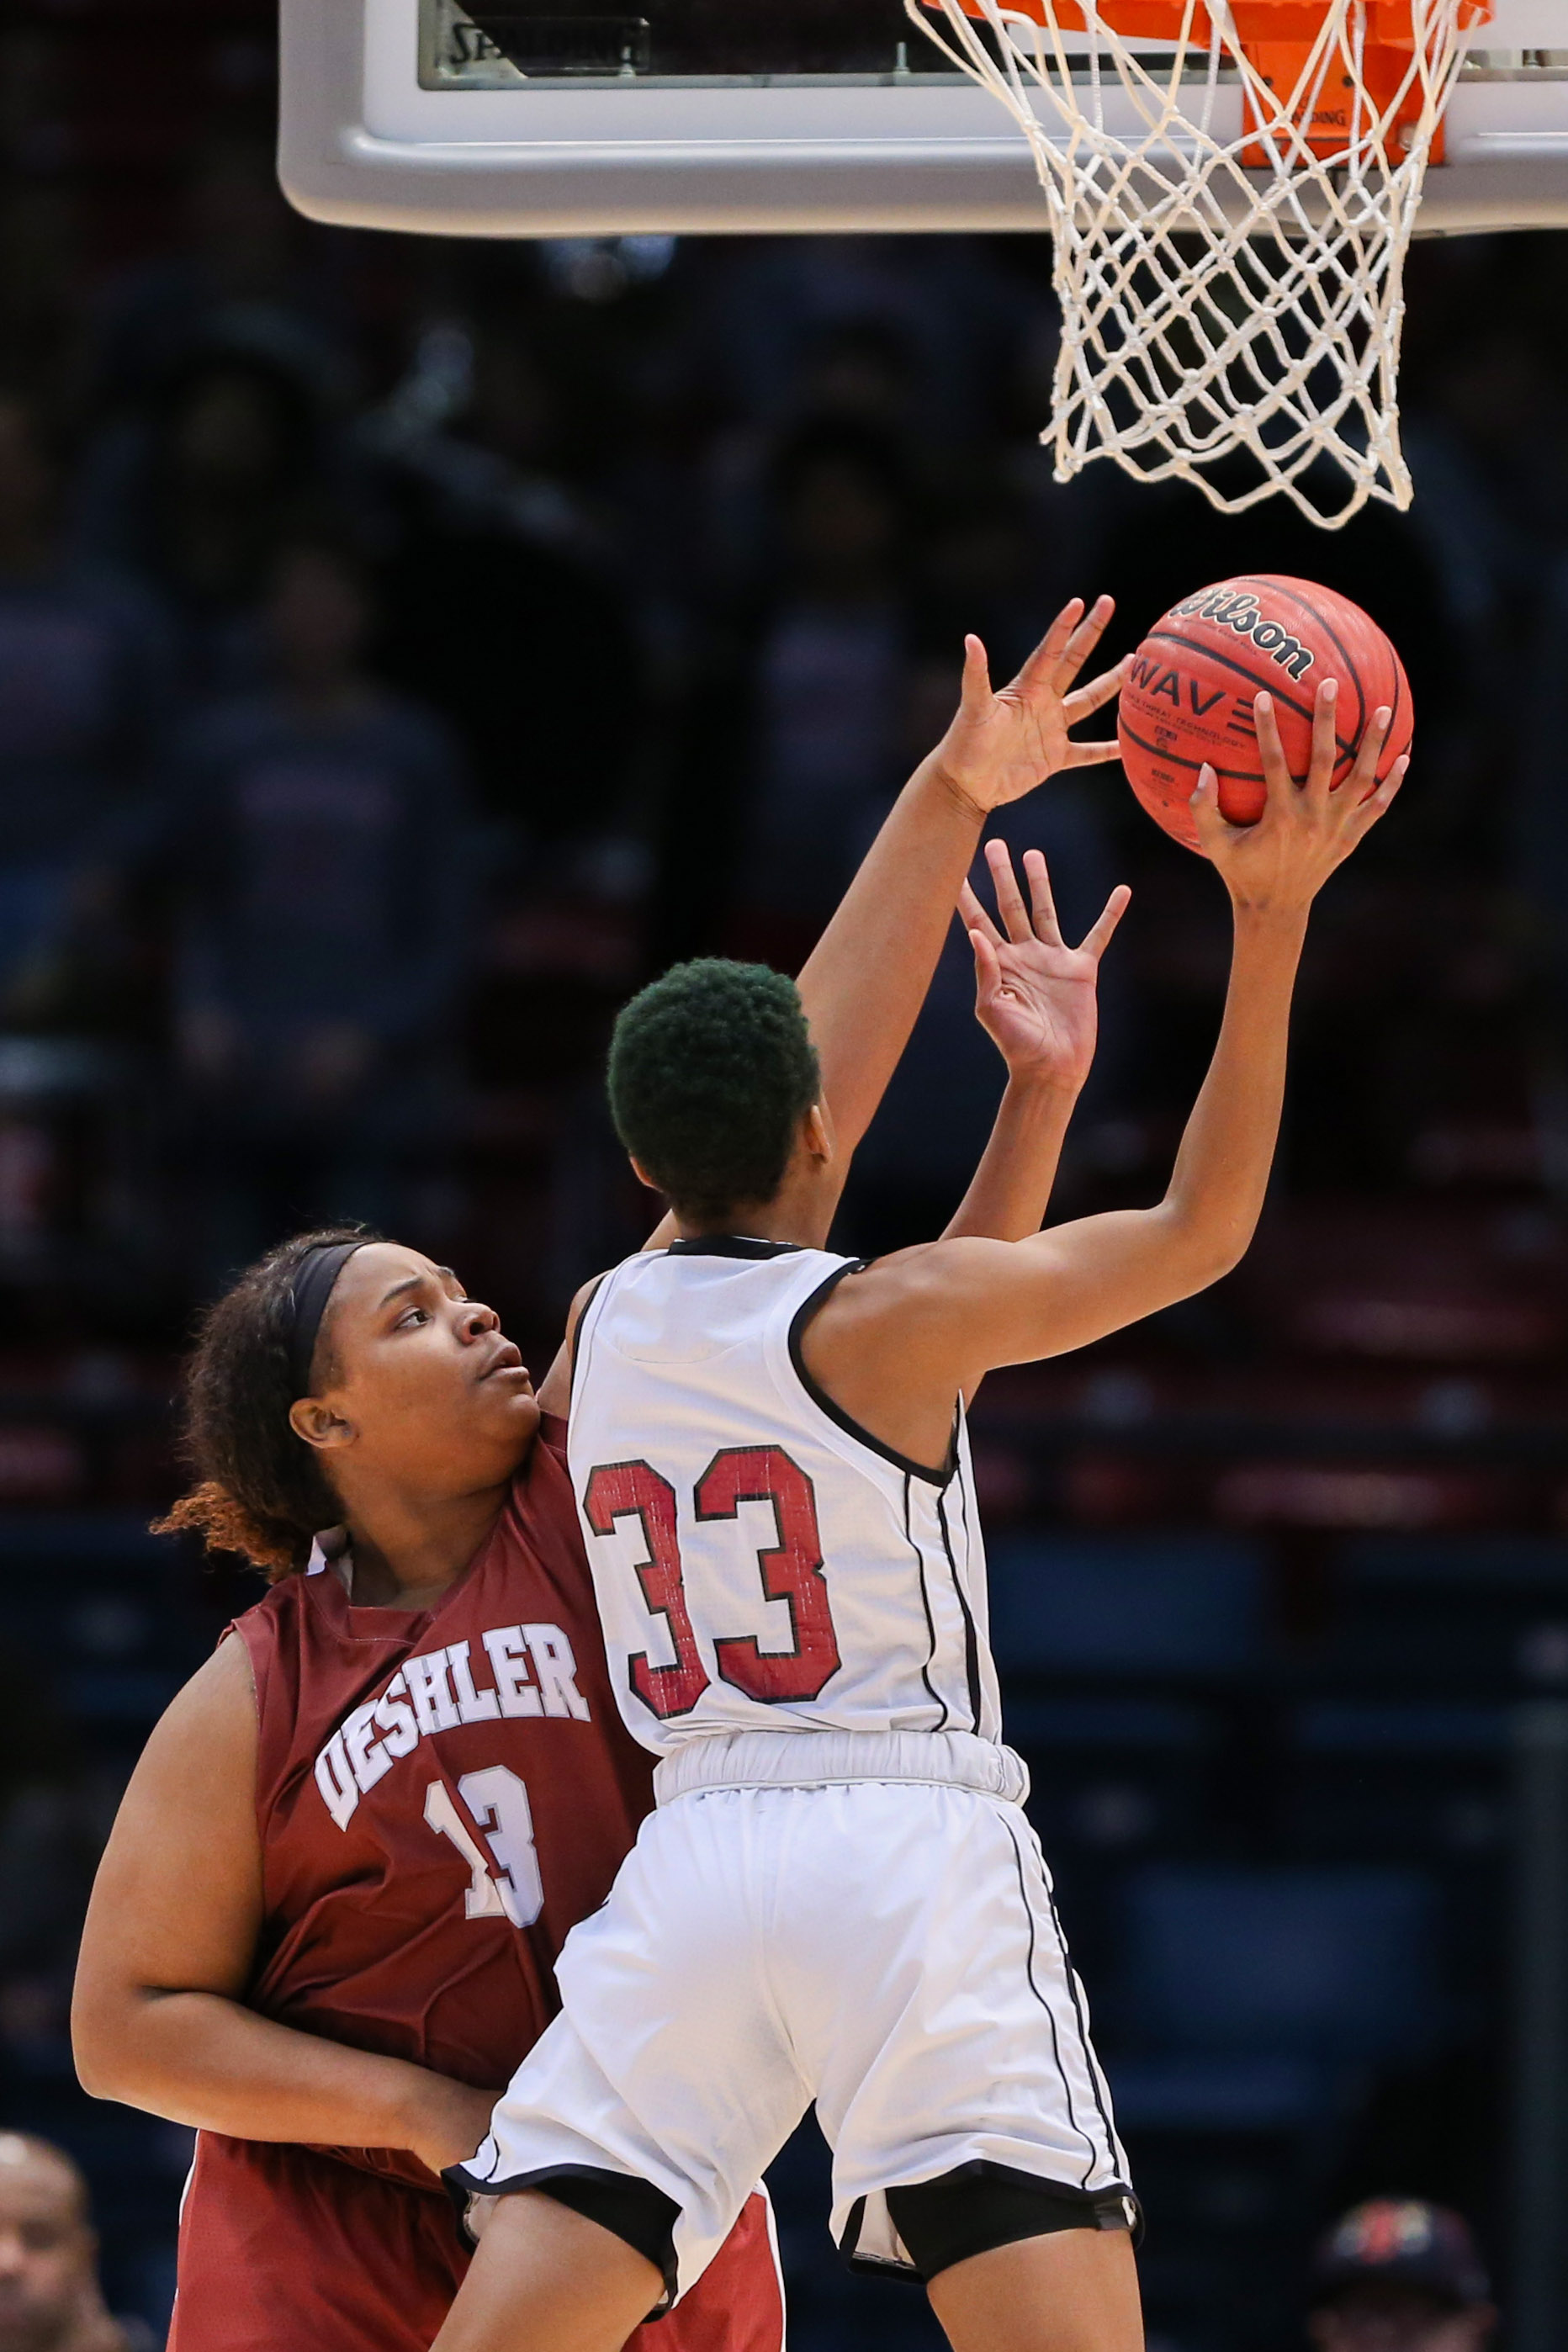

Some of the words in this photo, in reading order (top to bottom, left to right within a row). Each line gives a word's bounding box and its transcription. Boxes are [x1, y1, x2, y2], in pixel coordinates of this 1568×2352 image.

[1169, 587, 1316, 682] Wilson
[583, 1444, 842, 1720] 33
[423, 1764, 545, 1930] 13
